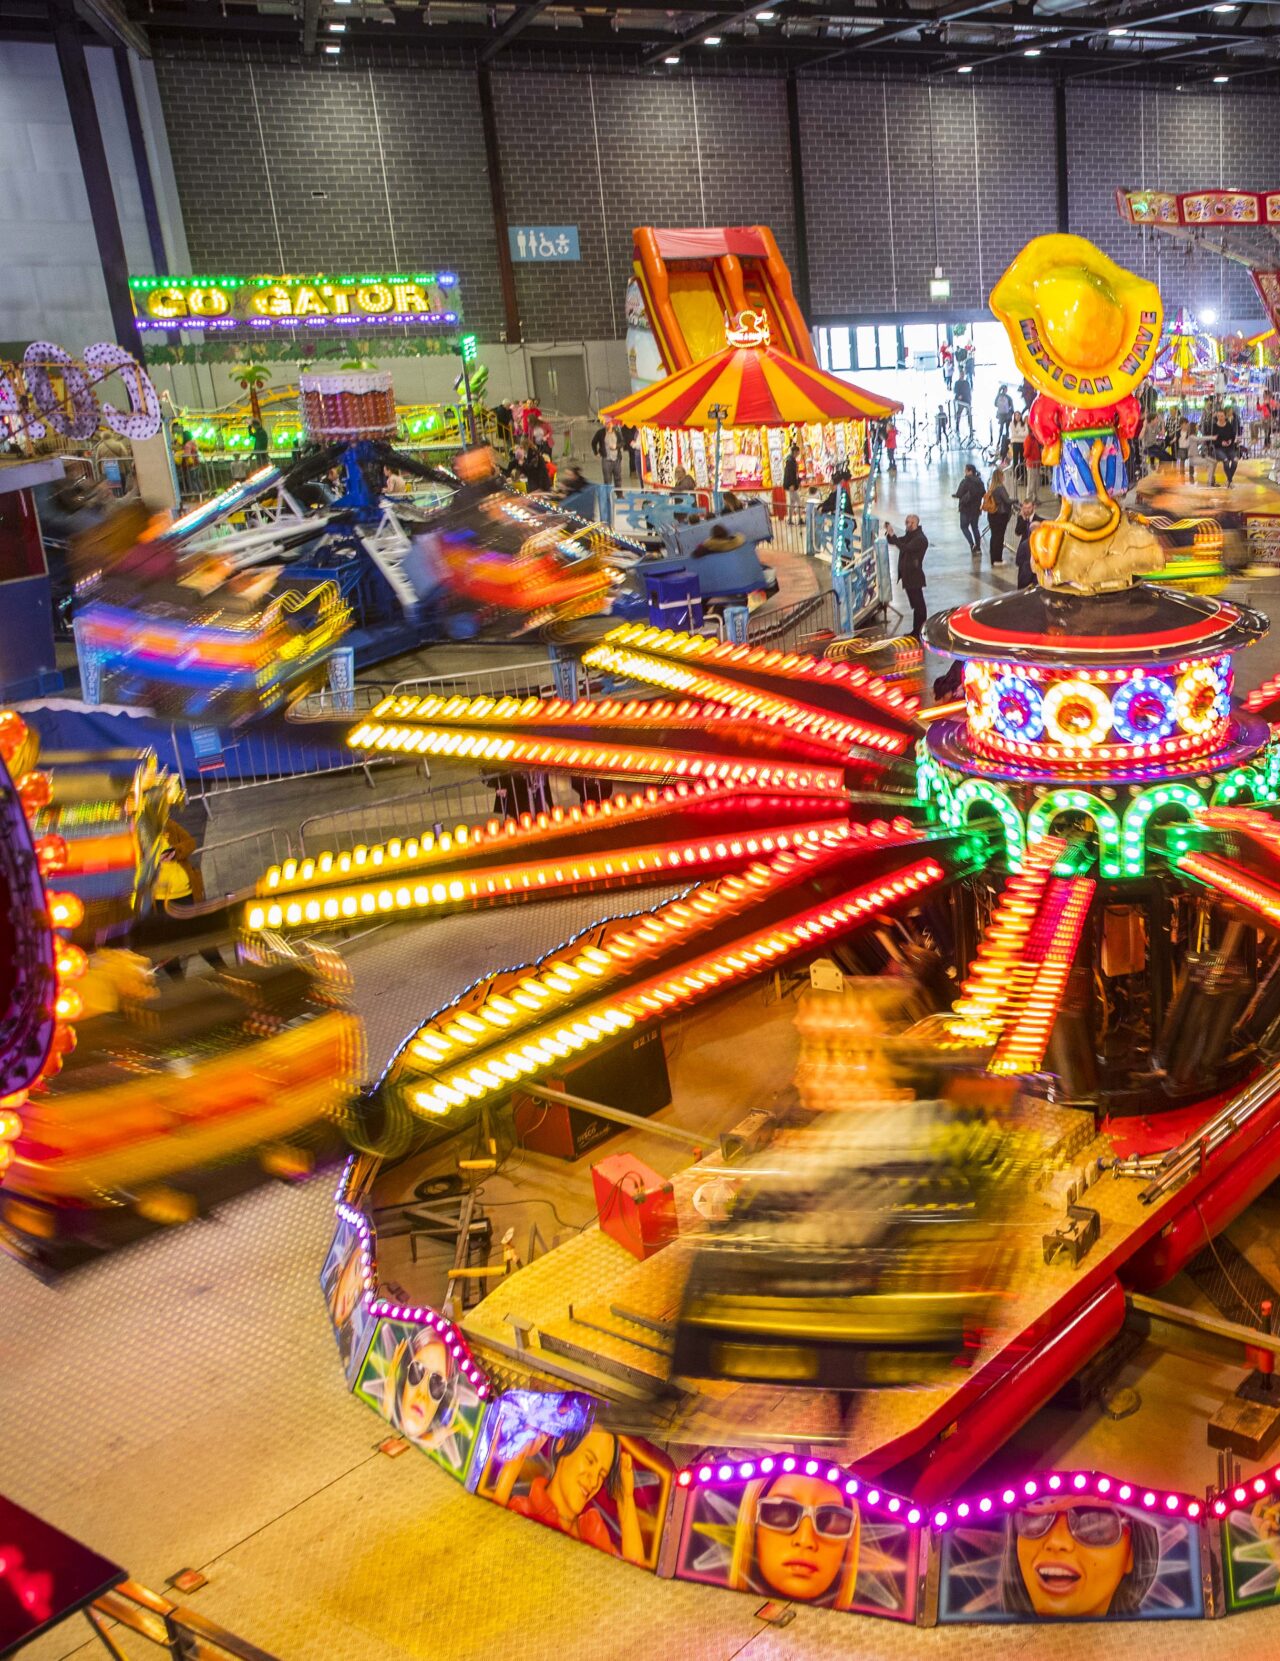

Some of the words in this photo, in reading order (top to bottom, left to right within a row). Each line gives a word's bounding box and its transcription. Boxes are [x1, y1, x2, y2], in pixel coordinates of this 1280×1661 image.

[149, 287, 232, 318] GO
[252, 283, 431, 316] GATOR
[1019, 318, 1113, 395] MEXICAN
[1119, 311, 1157, 376] WAVE
